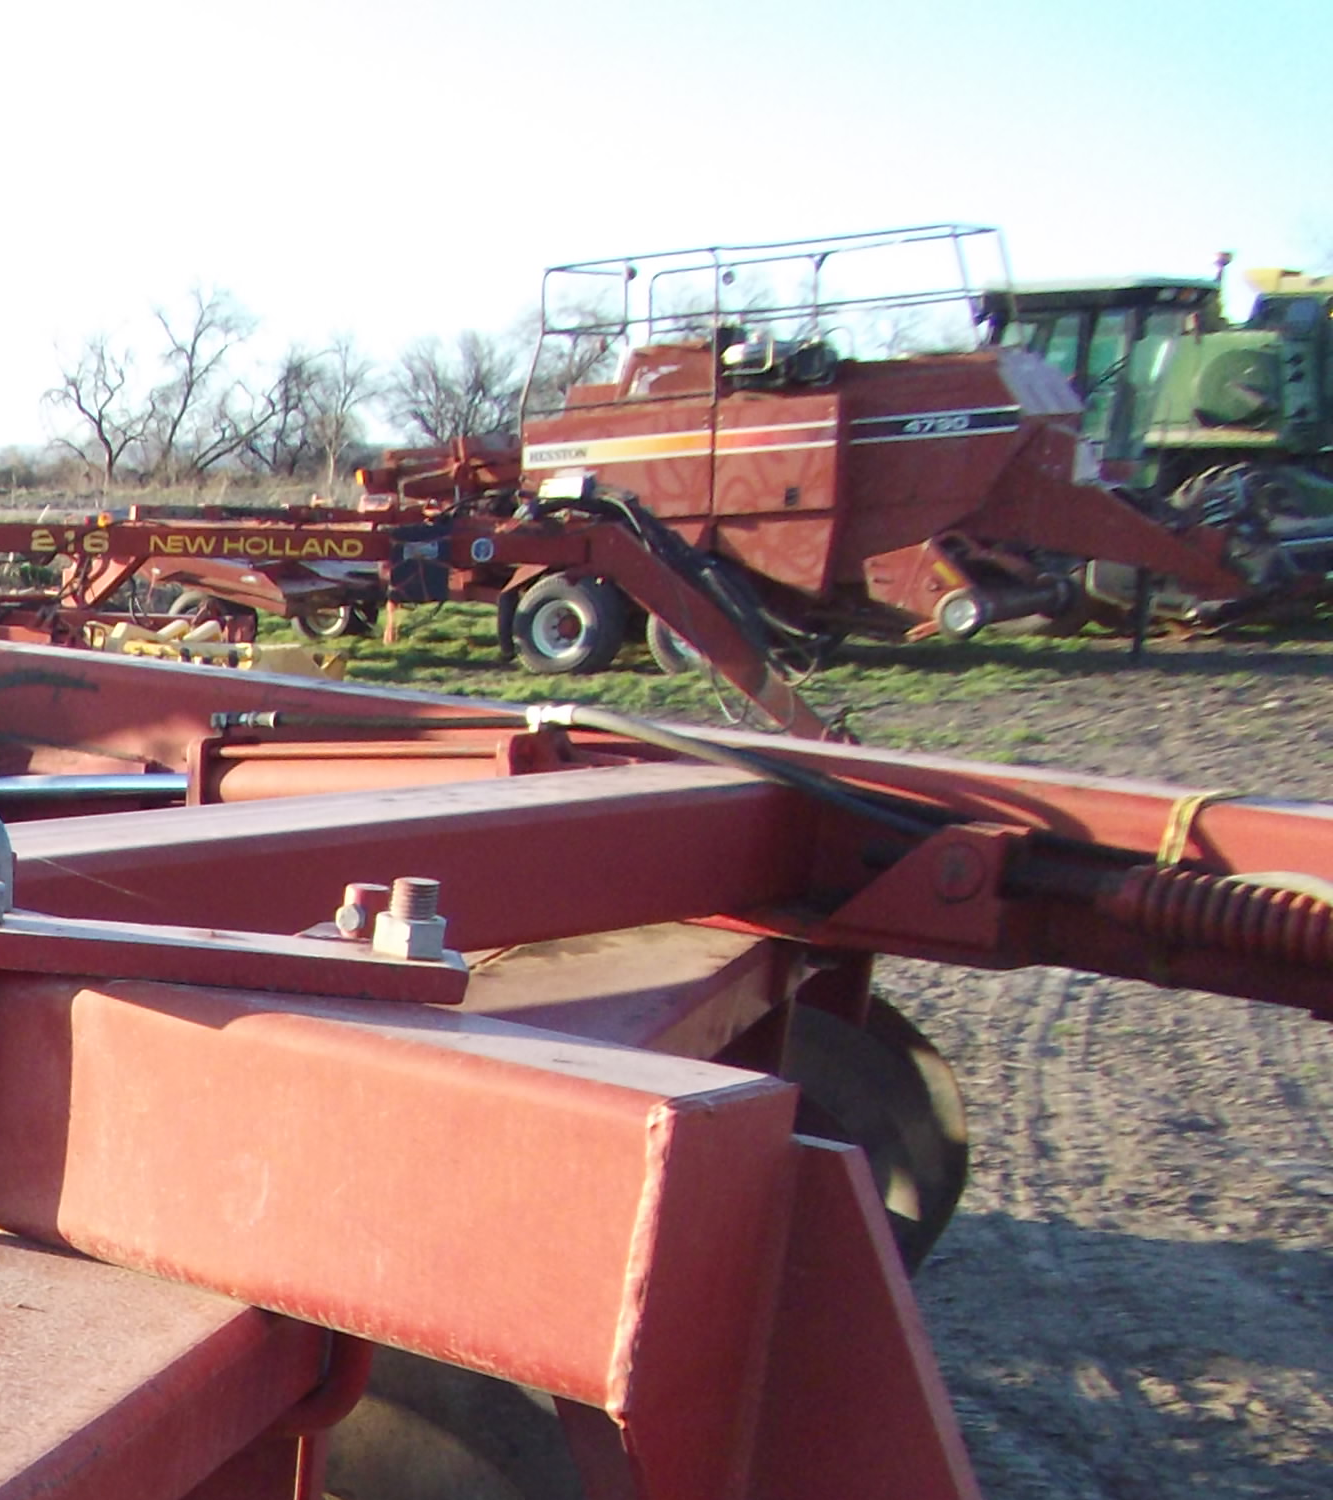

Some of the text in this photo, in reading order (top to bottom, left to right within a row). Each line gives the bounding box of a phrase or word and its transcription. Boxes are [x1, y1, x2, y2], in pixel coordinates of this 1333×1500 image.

[528, 446, 589, 463] HESSTON
[149, 535, 364, 557] NEW HOLLAND
